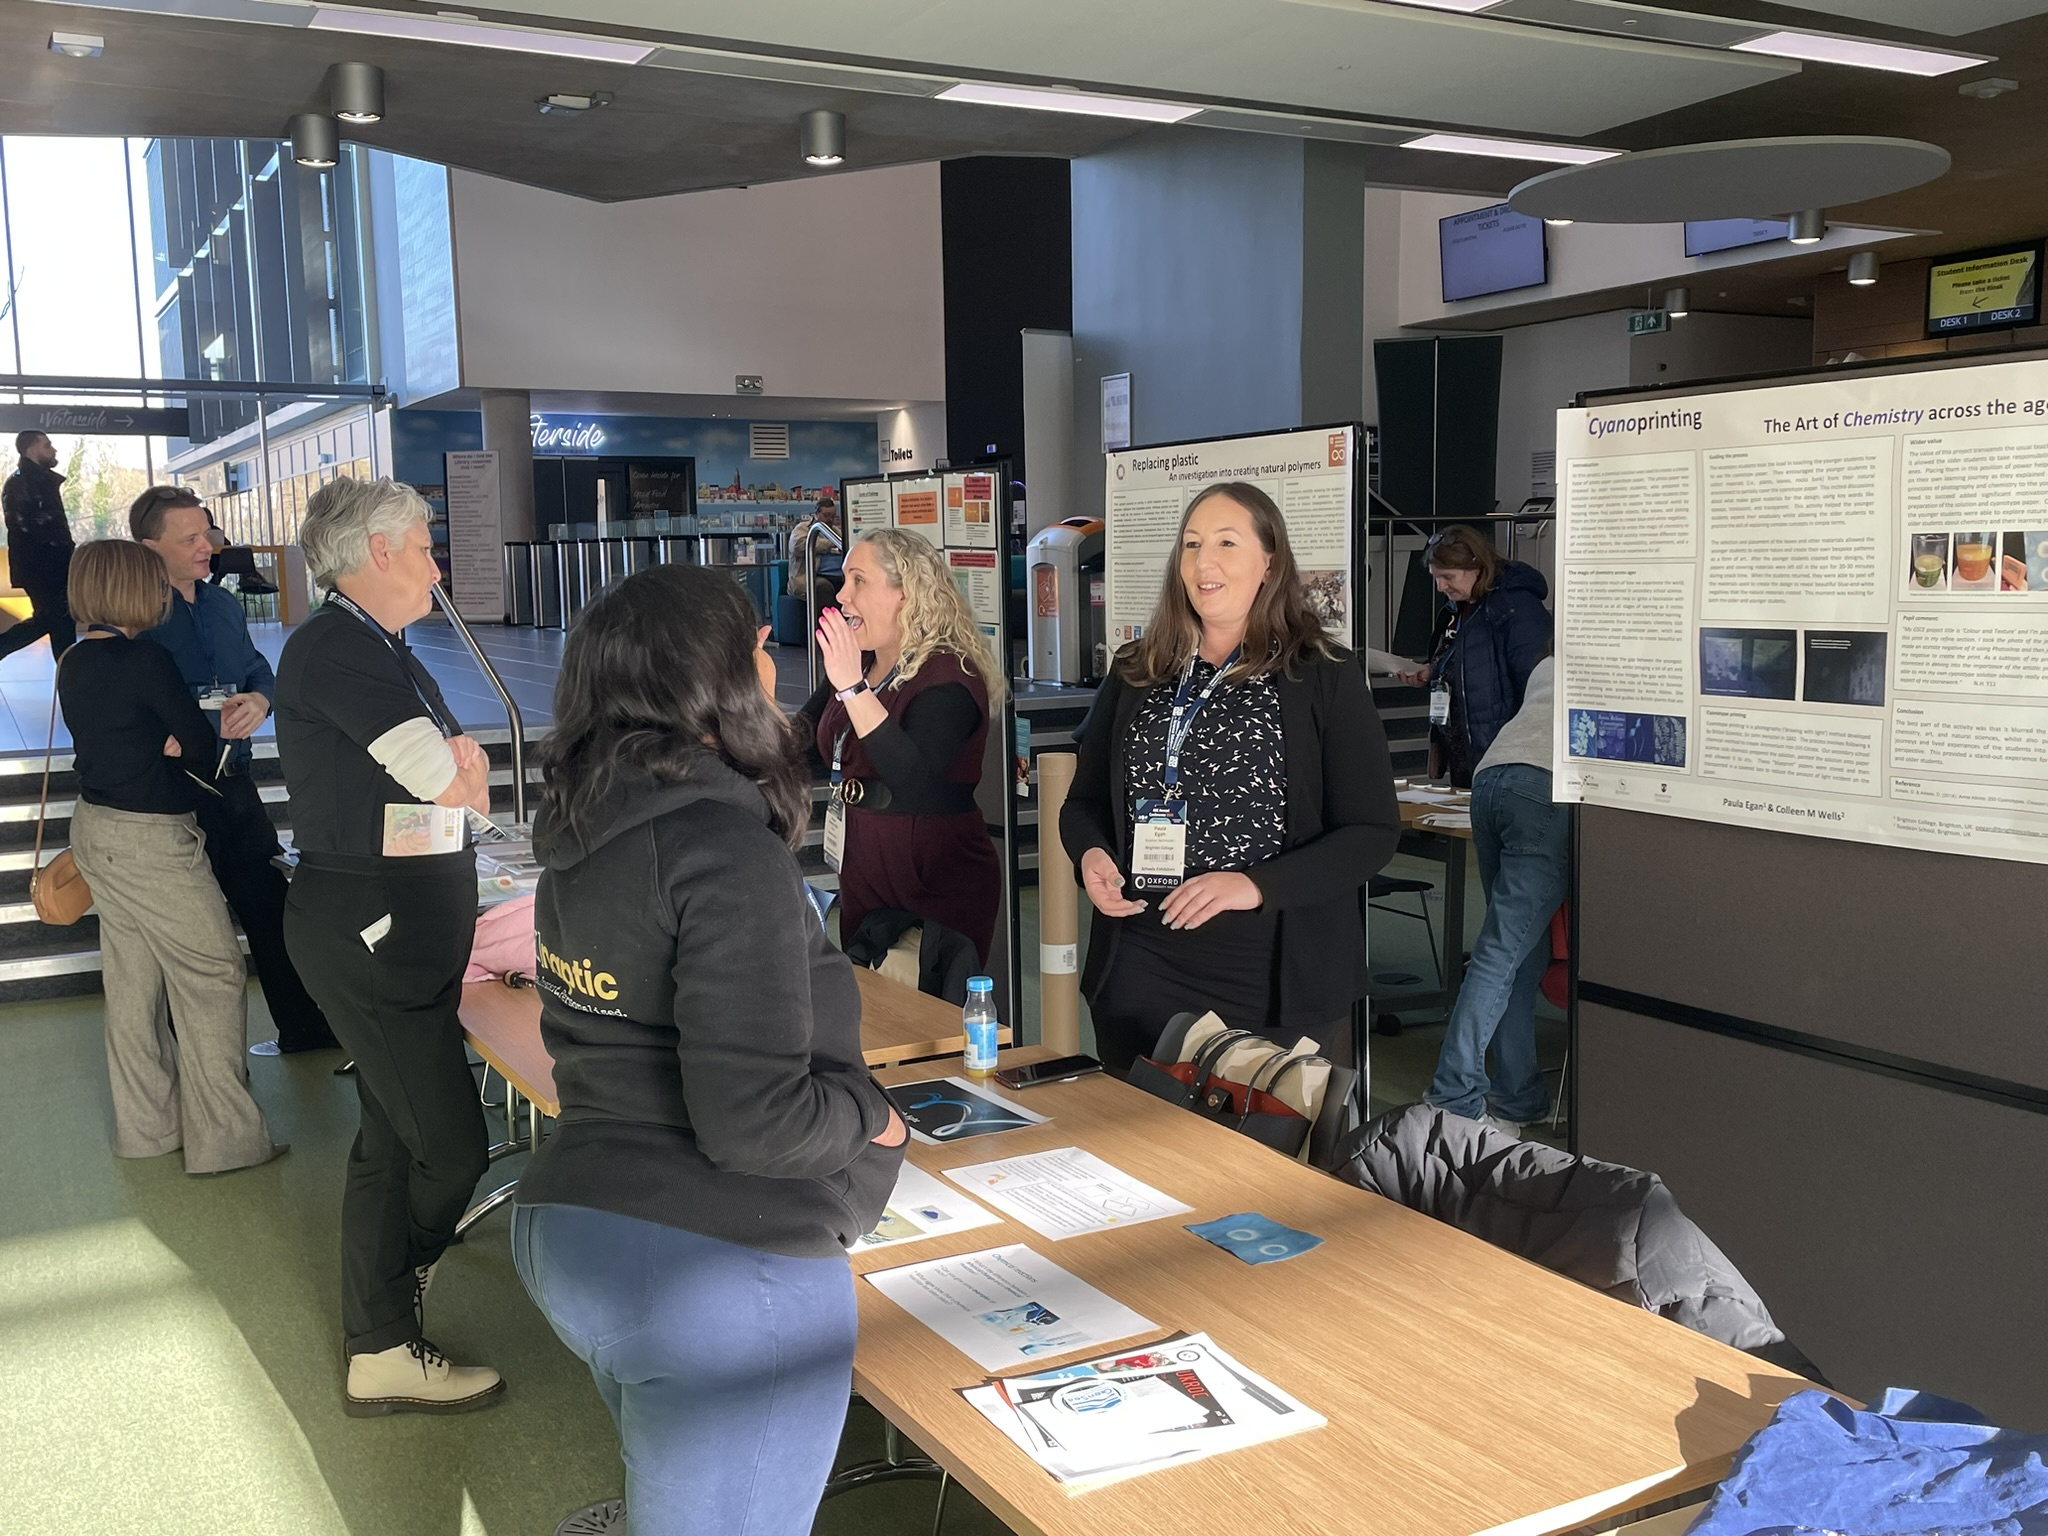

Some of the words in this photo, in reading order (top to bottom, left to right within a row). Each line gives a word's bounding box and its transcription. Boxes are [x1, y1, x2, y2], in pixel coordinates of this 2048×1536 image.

[1937, 268, 1964, 276] Student
[1966, 259, 2008, 272] Information
[2010, 256, 2028, 265] Desk
[1972, 278, 1986, 286] take
[1940, 317, 1961, 328] DESK
[1964, 316, 1967, 324] 1
[1991, 310, 2013, 320] DESK
[2016, 309, 2020, 317] 2
[40, 408, 108, 429] Waterside
[1589, 408, 1702, 439] Cyanoprinting
[1764, 418, 1790, 434] The
[1795, 416, 1818, 431] Art
[1823, 413, 1839, 429] of
[1844, 408, 1924, 428] Chemistry
[1929, 404, 1981, 420] across
[1987, 398, 2017, 415] the
[2023, 399, 2048, 416] ag
[530, 414, 606, 449] terside
[890, 448, 912, 462] Toilets
[1132, 455, 1169, 472] Replacing
[1172, 453, 1199, 470] plastic
[1169, 472, 1177, 481] An
[1179, 468, 1218, 482] investigation
[1219, 467, 1232, 478] into
[1233, 464, 1259, 478] creating
[1260, 462, 1286, 474] natural
[1288, 460, 1321, 473] polymers
[1895, 780, 1921, 788] Reference
[1723, 798, 1744, 808] Paula
[1768, 804, 1774, 812] &
[1776, 805, 1805, 816] Colleen
[1808, 809, 1815, 818] M
